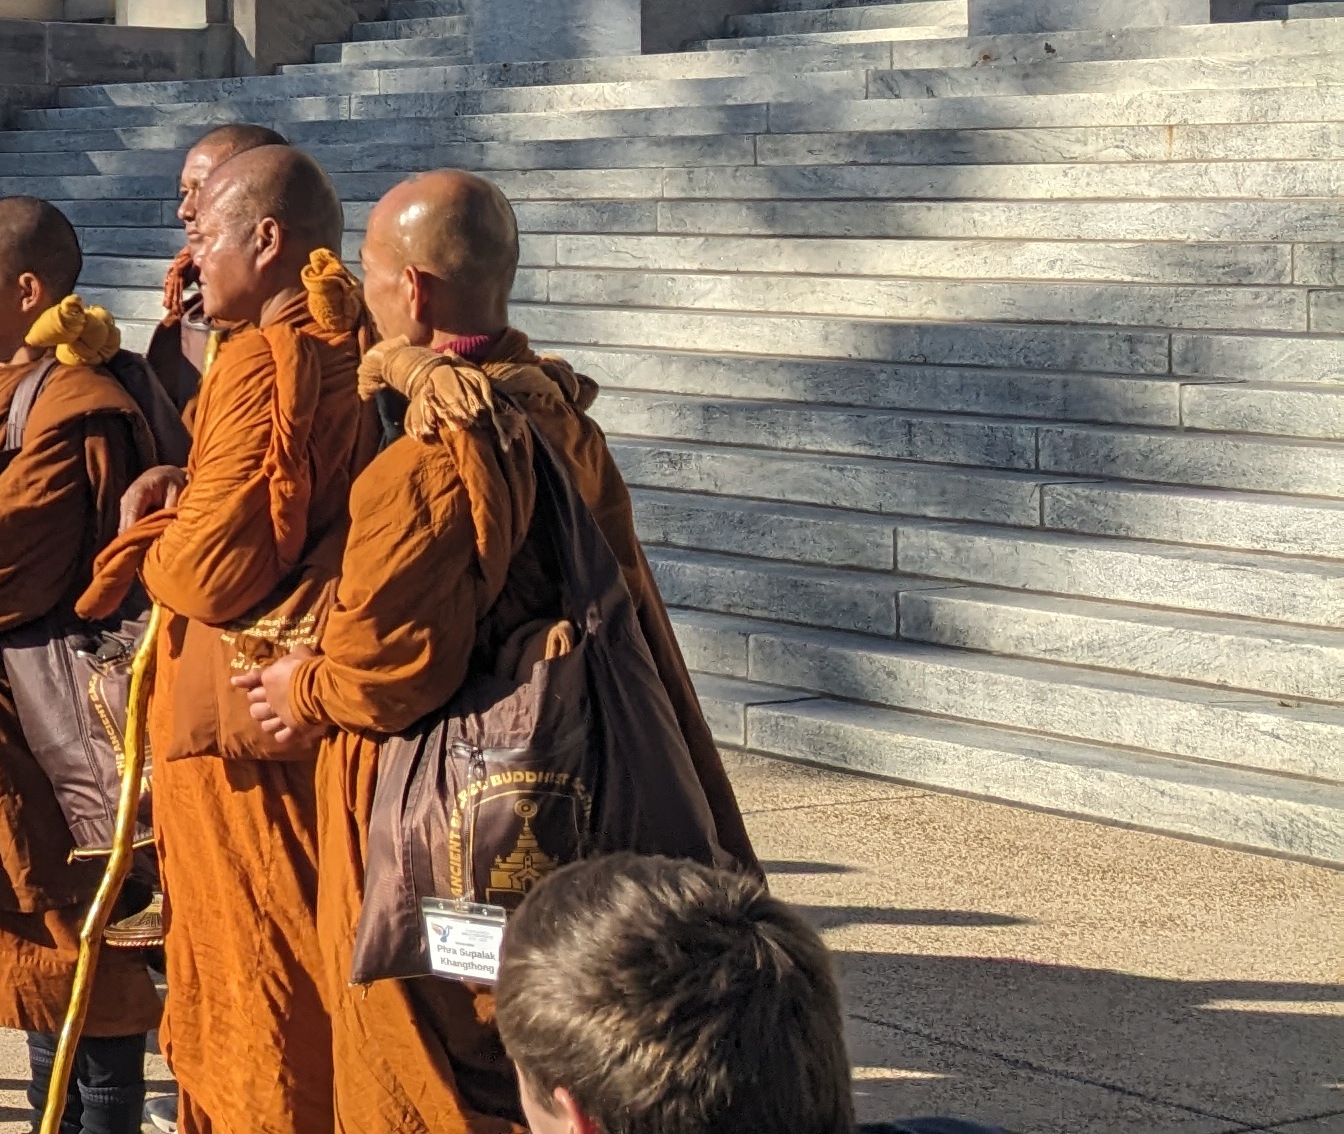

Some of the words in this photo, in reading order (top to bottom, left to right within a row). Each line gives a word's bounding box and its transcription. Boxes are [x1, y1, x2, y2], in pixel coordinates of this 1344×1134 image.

[94, 703, 122, 752] ANCIENT
[448, 832, 463, 896] ANCIENT
[490, 770, 570, 786] BUDDHIST
[437, 944, 457, 956] Phra
[459, 948, 496, 960] Supalak
